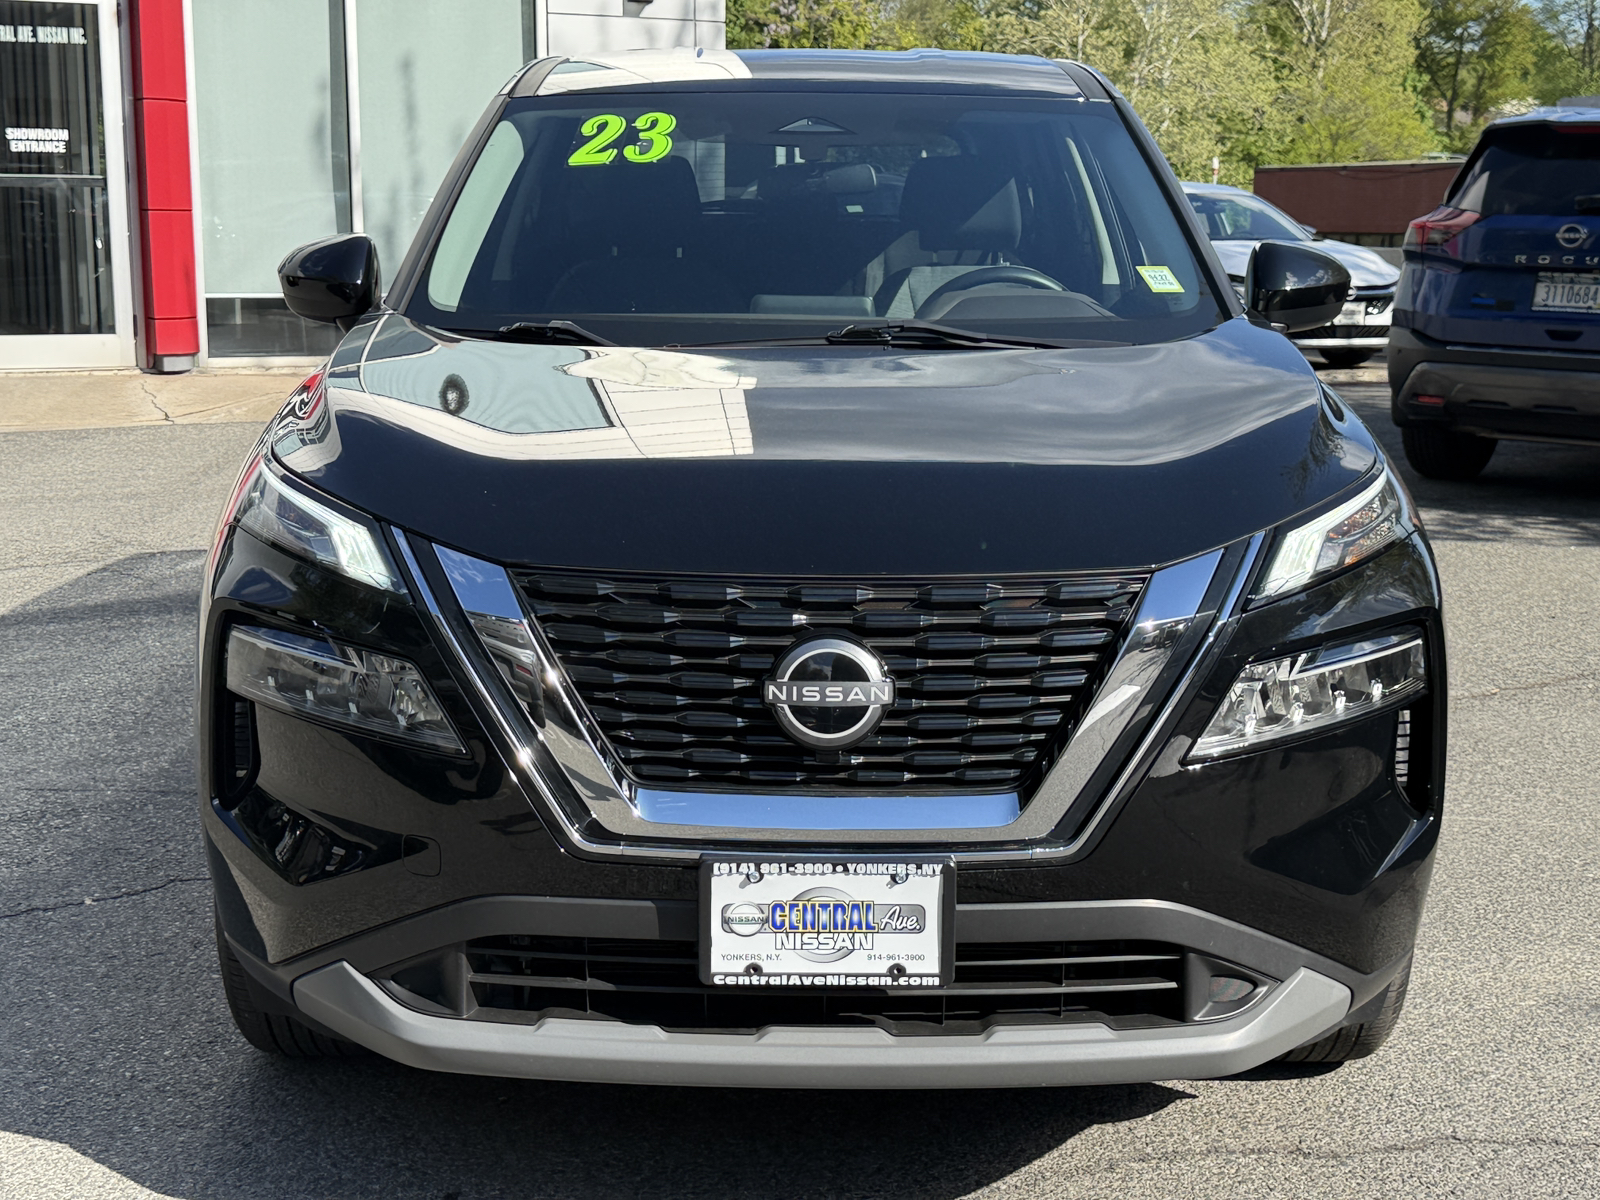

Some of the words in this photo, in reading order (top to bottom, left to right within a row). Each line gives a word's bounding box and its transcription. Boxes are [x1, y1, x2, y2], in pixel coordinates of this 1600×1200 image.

[37, 26, 68, 44] NISSAN
[69, 27, 87, 45] INC.
[5, 127, 69, 141] SHOWROOM
[567, 111, 677, 166] 23
[10, 140, 67, 153] ENTRANCE
[768, 685, 889, 702] NISSAN
[760, 862, 833, 875] 961-3900
[727, 915, 765, 923] NISSAN
[768, 900, 879, 933] CENTRAL
[880, 904, 922, 931] Ave.
[775, 932, 874, 951] NISSAN
[721, 953, 764, 962] YONKERS,
[766, 953, 782, 961] N.Y.
[866, 953, 926, 961] 914-961-3900
[712, 974, 941, 987] CentralAveNissan.com
